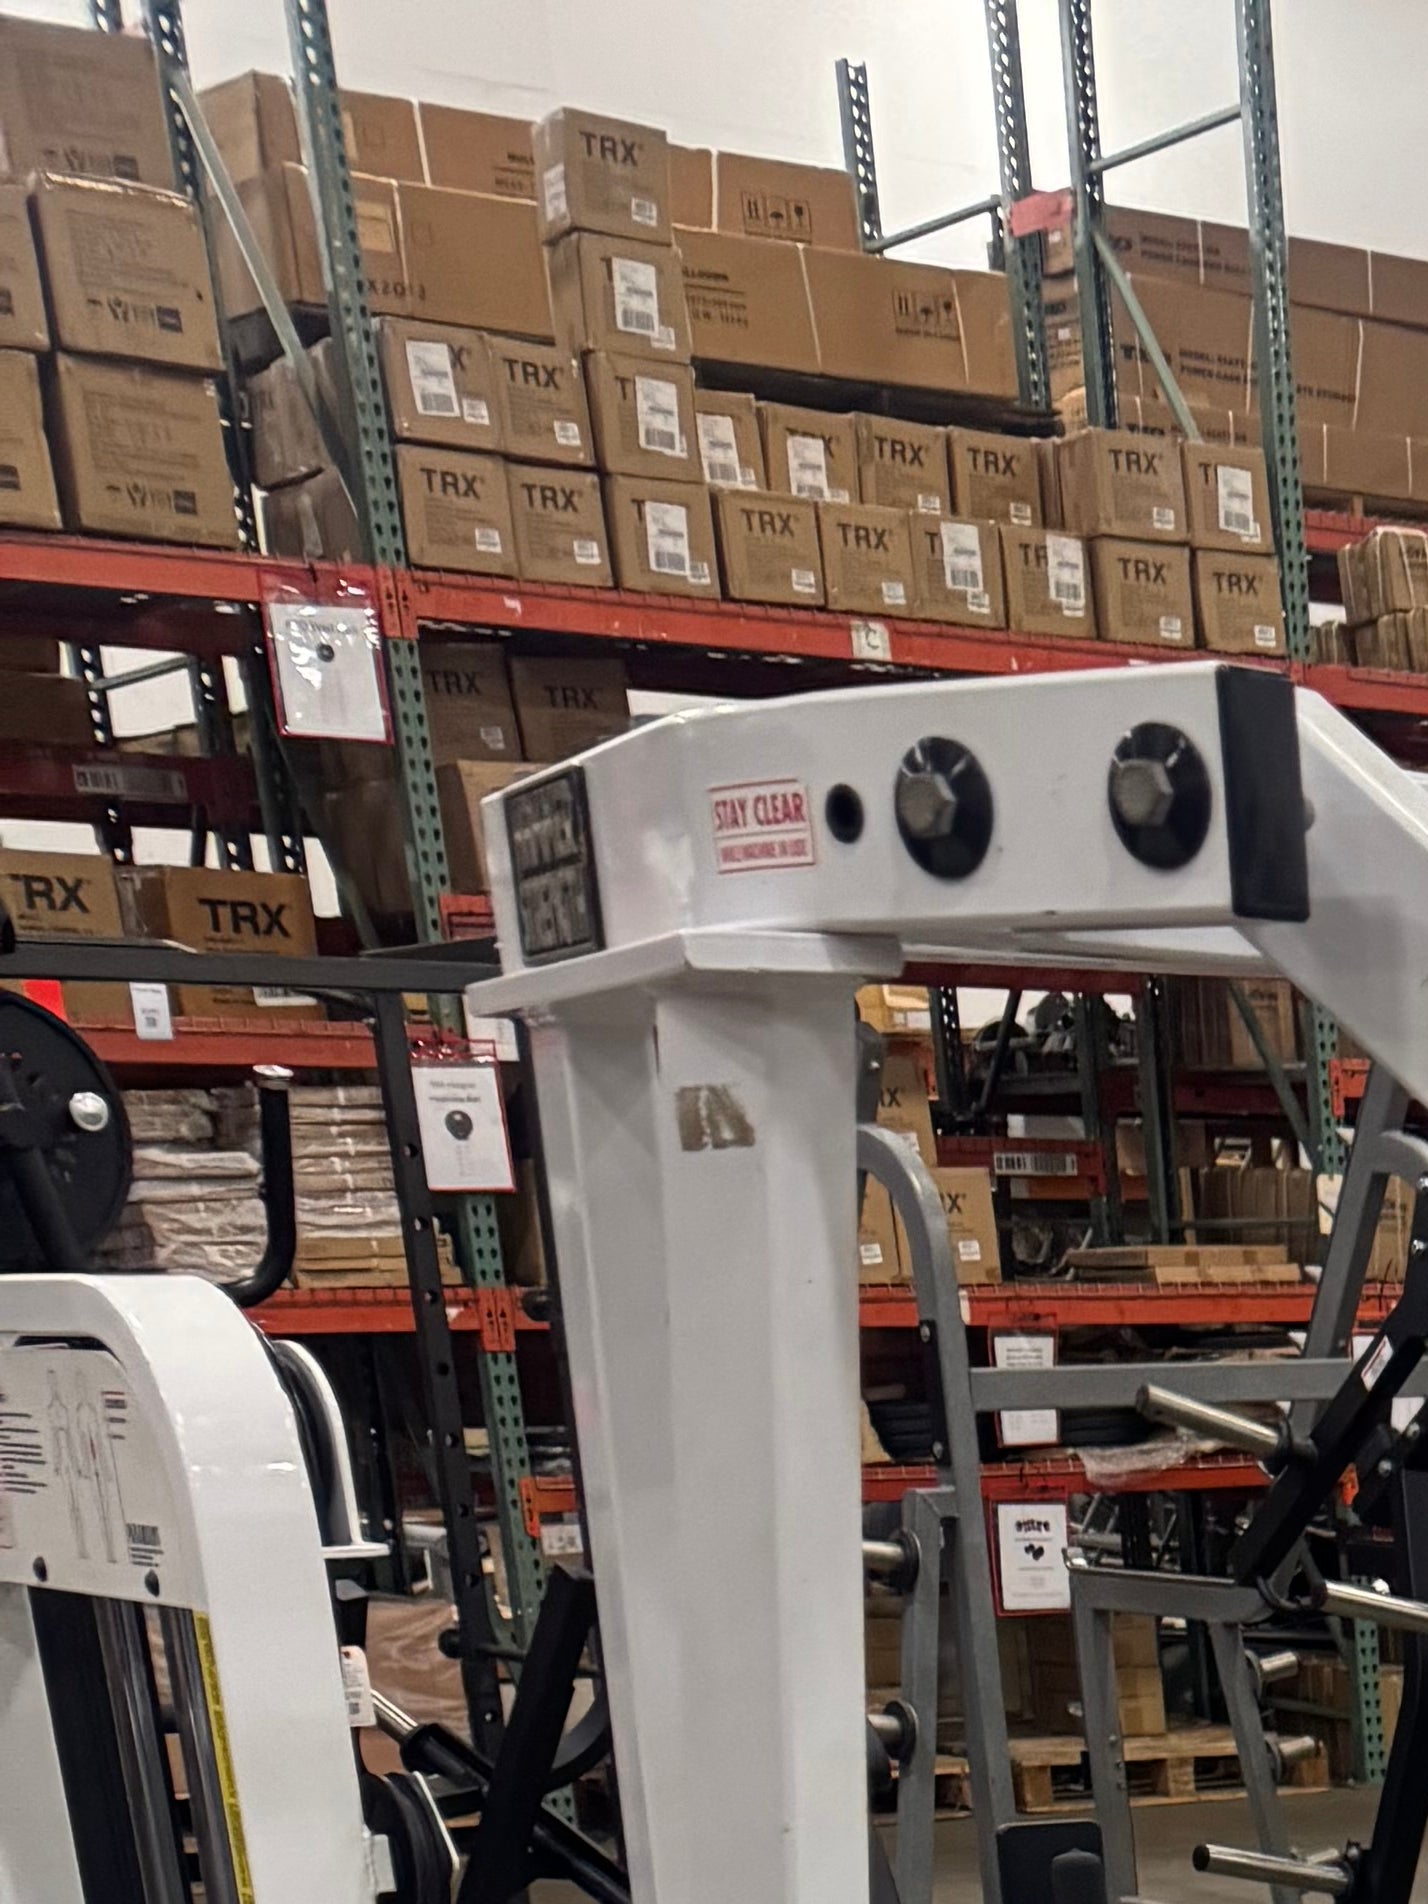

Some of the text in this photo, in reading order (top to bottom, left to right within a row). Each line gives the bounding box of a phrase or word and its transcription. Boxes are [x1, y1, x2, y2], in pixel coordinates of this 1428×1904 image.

[579, 131, 638, 167] TRX
[502, 356, 561, 390] TRX
[874, 435, 924, 468] TRX
[966, 447, 1016, 478] TRX
[1107, 449, 1160, 475] TRX
[420, 467, 480, 499] TRX
[521, 482, 579, 513] TRX
[740, 508, 795, 538] TRX
[836, 522, 890, 552] TRX
[1018, 542, 1048, 569] TR
[1117, 557, 1167, 585] TRX
[1211, 571, 1259, 596] TRX
[714, 792, 806, 832] STAY CLEAR
[197, 898, 292, 938] TRX
